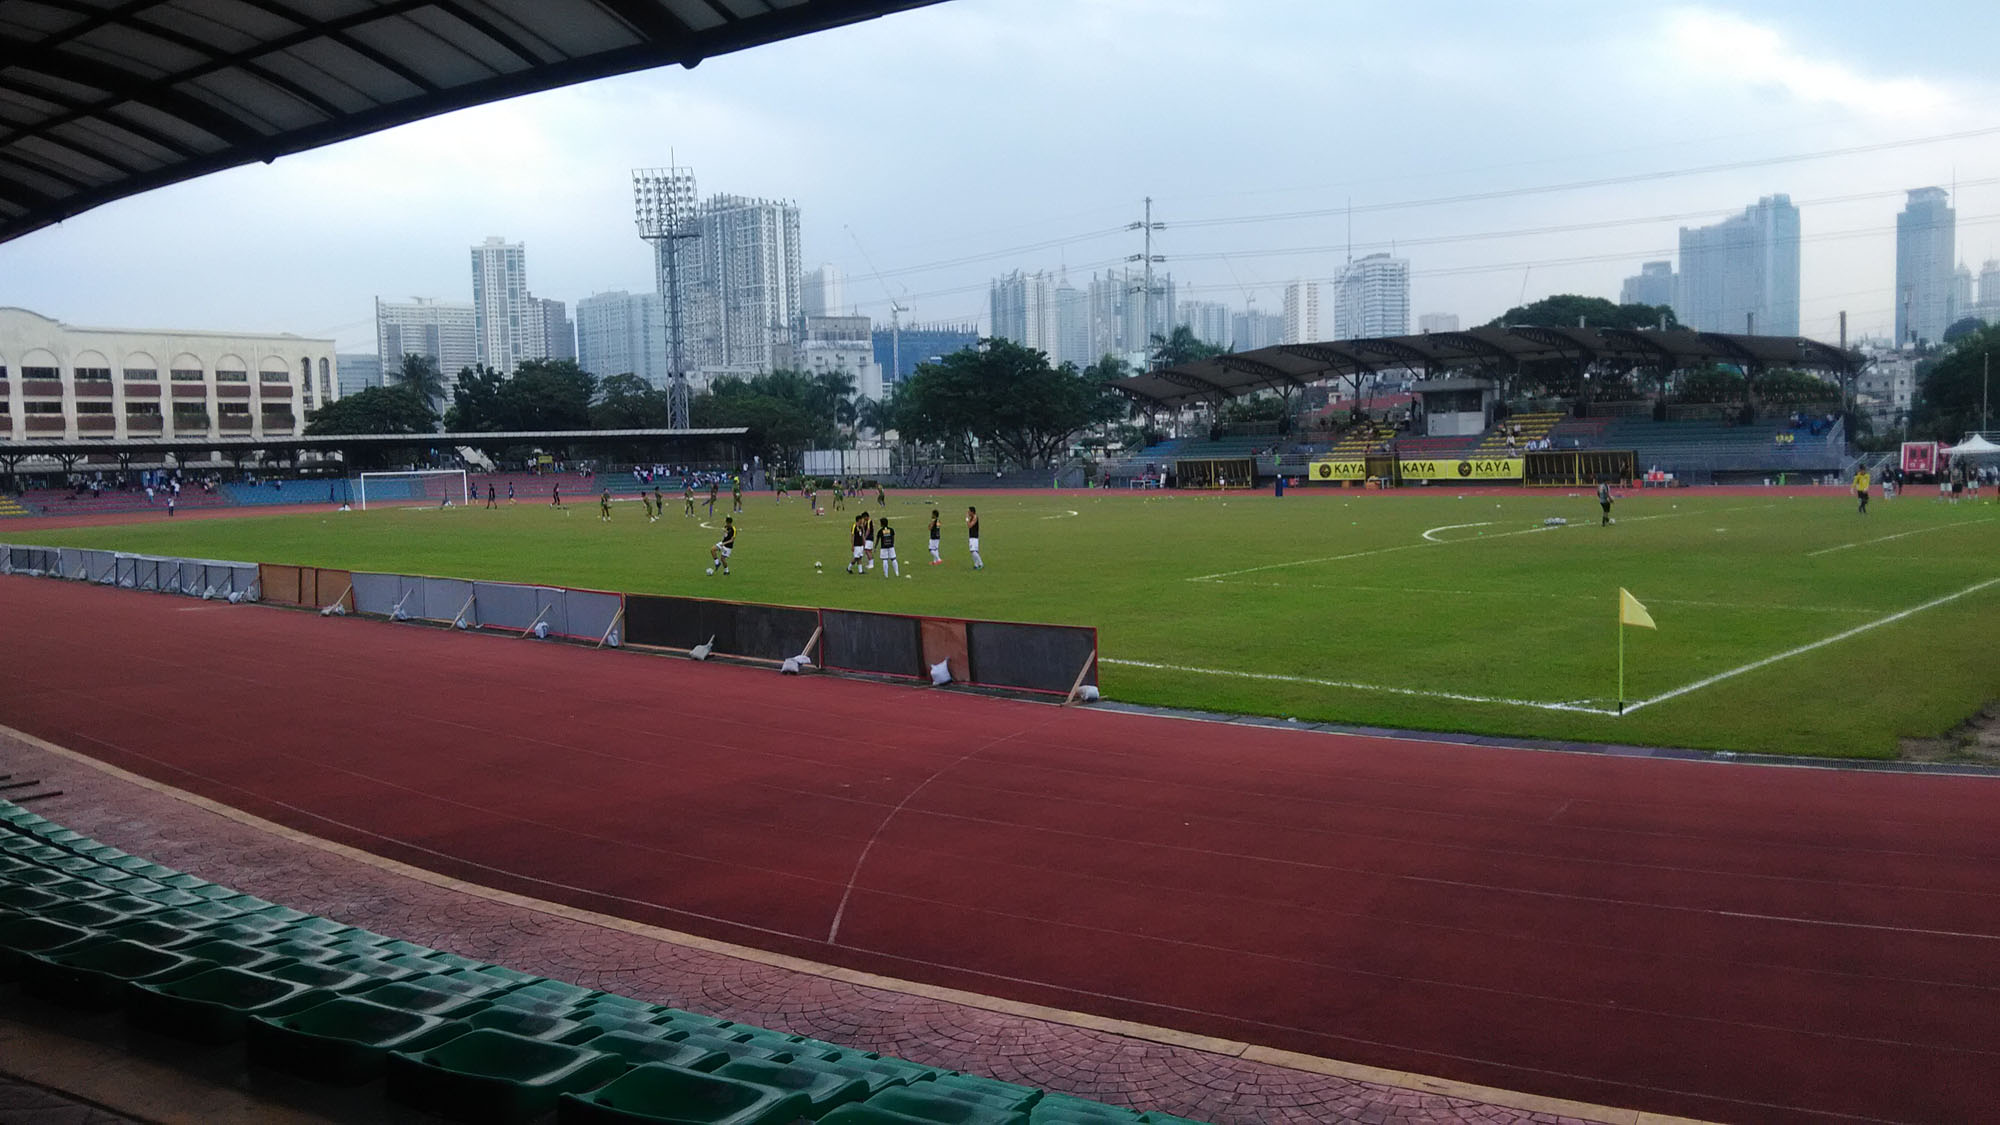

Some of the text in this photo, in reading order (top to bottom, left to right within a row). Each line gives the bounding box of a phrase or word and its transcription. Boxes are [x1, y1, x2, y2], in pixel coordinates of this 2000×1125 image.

[1334, 463, 1365, 474] KAYA
[1402, 462, 1435, 473] KAYA
[1475, 461, 1511, 472] KAYA
